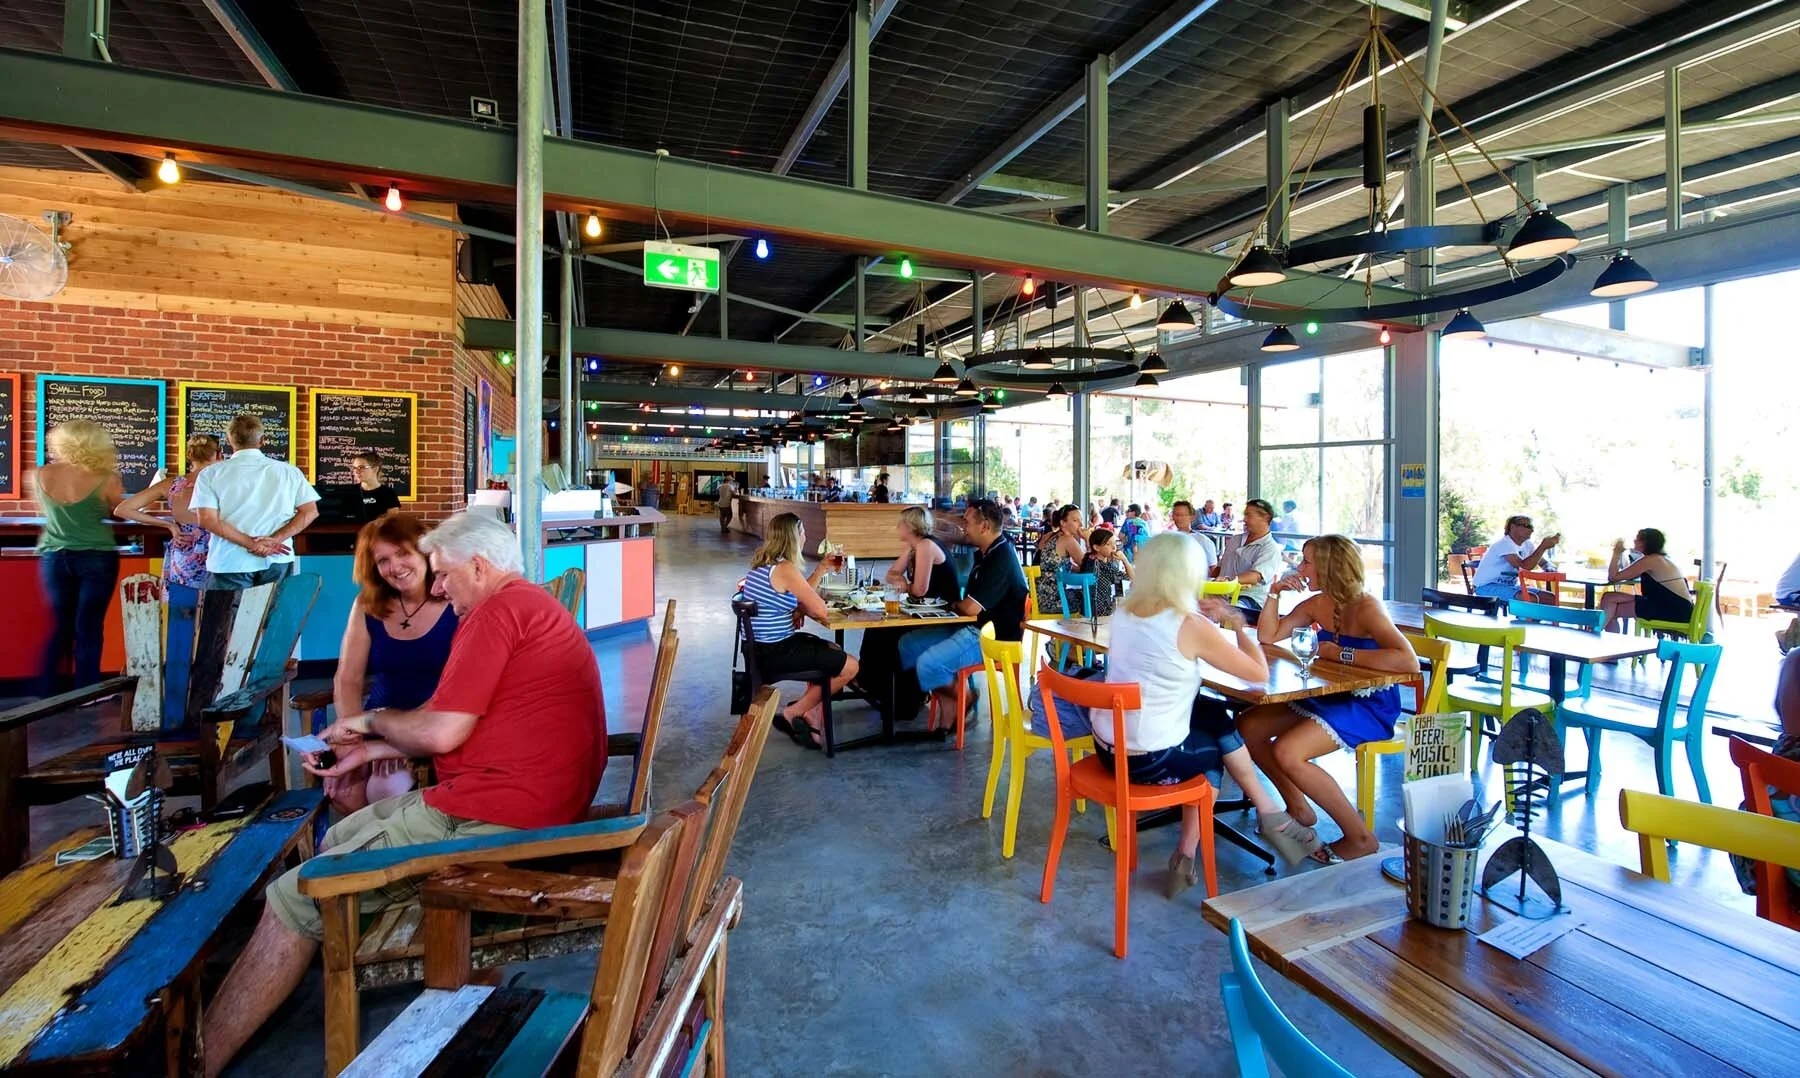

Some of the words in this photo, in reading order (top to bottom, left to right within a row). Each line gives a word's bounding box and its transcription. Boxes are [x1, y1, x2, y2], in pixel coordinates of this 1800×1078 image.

[49, 383, 81, 395] SMALL
[82, 385, 105, 399] FOOD
[1415, 716, 1435, 729] FISH!
[1414, 728, 1445, 746] BEER!
[124, 748, 136, 757] ALL
[1410, 745, 1456, 765] MUSIC!
